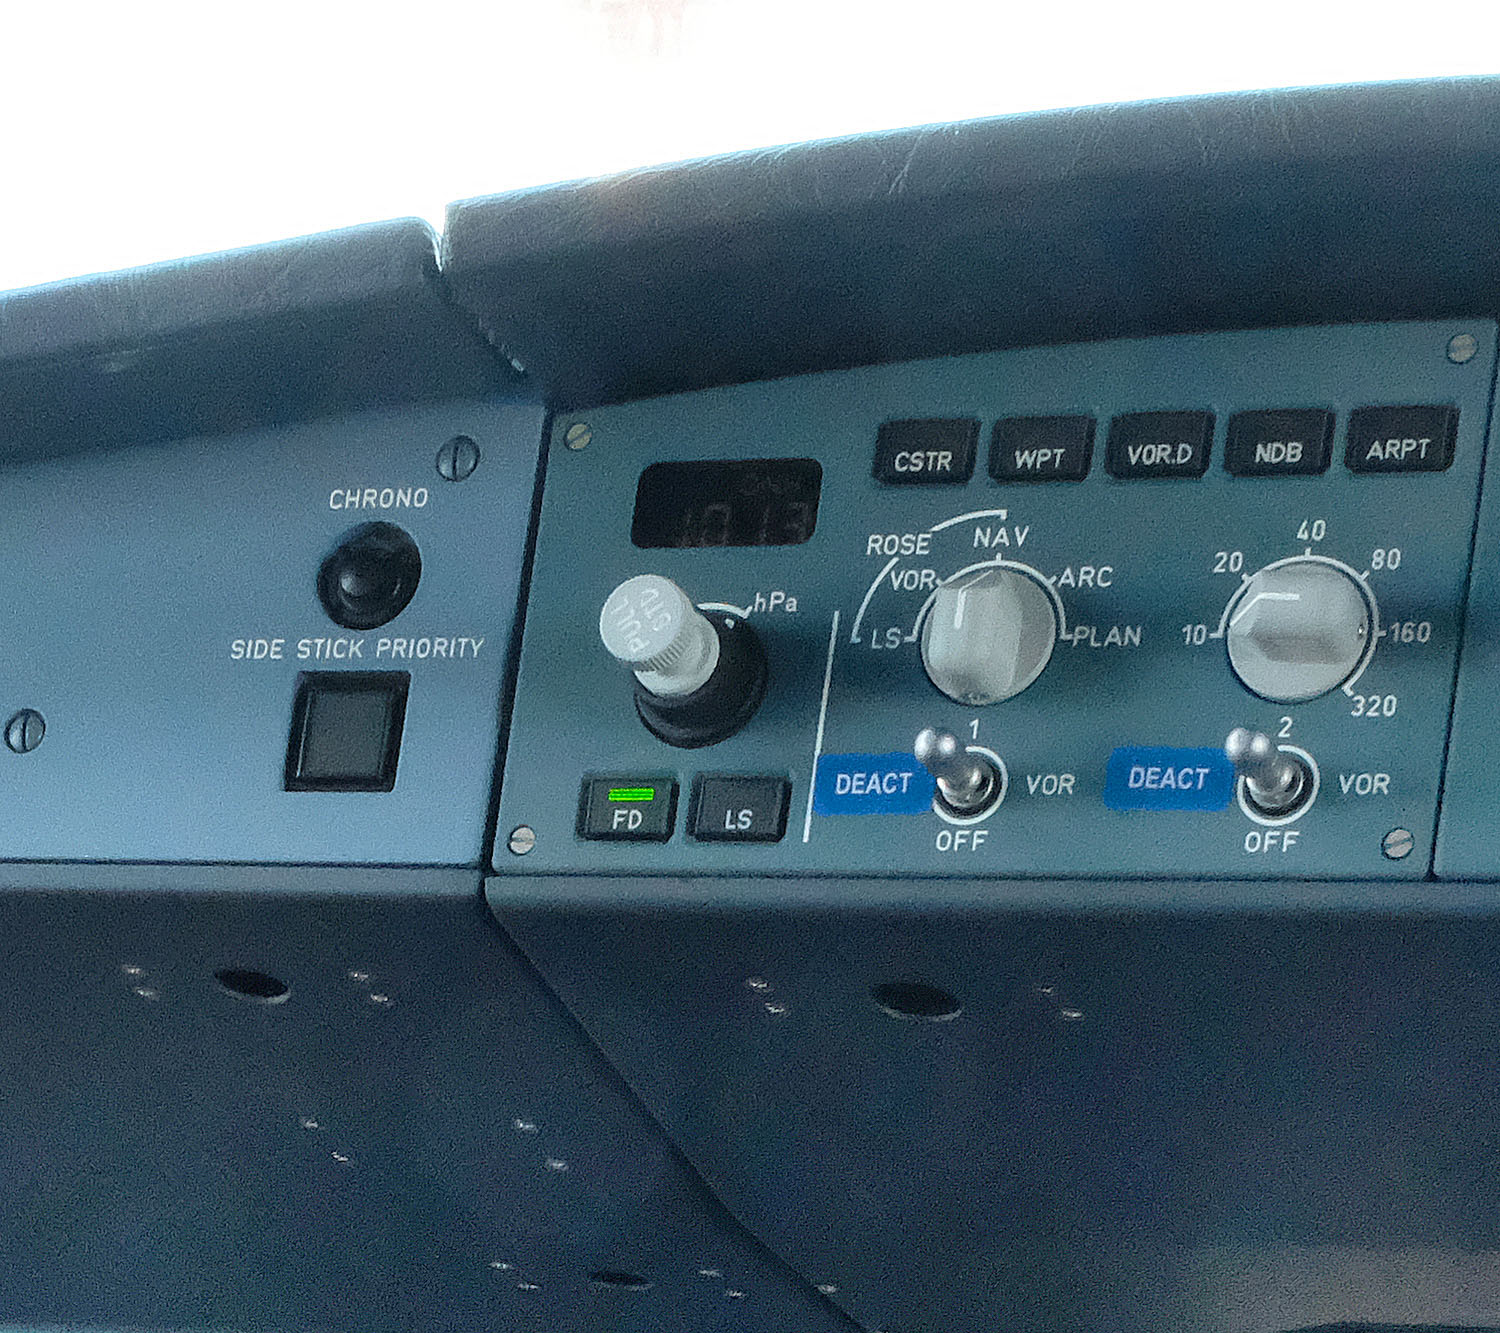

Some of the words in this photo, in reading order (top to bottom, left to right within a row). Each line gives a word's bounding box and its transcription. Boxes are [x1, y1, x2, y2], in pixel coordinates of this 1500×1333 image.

[1013, 446, 1064, 471] WPT
[1127, 441, 1193, 466] VOR.D
[1254, 440, 1303, 464] NDB
[1366, 436, 1430, 461] ARPT
[894, 448, 952, 473] CSTR
[329, 488, 429, 510] CHRONO
[867, 533, 930, 555] ROSE
[973, 525, 1030, 548] NAV
[753, 592, 798, 612] hPa
[1073, 625, 1141, 648] PLAN
[1390, 621, 1431, 644] 160
[230, 638, 285, 660] SIDE
[296, 638, 363, 660] STICK
[376, 637, 484, 660] PRIORITY
[1351, 695, 1397, 717] 320
[835, 770, 912, 796] DEACT
[1027, 773, 1075, 795] VOR
[613, 809, 642, 830] FD
